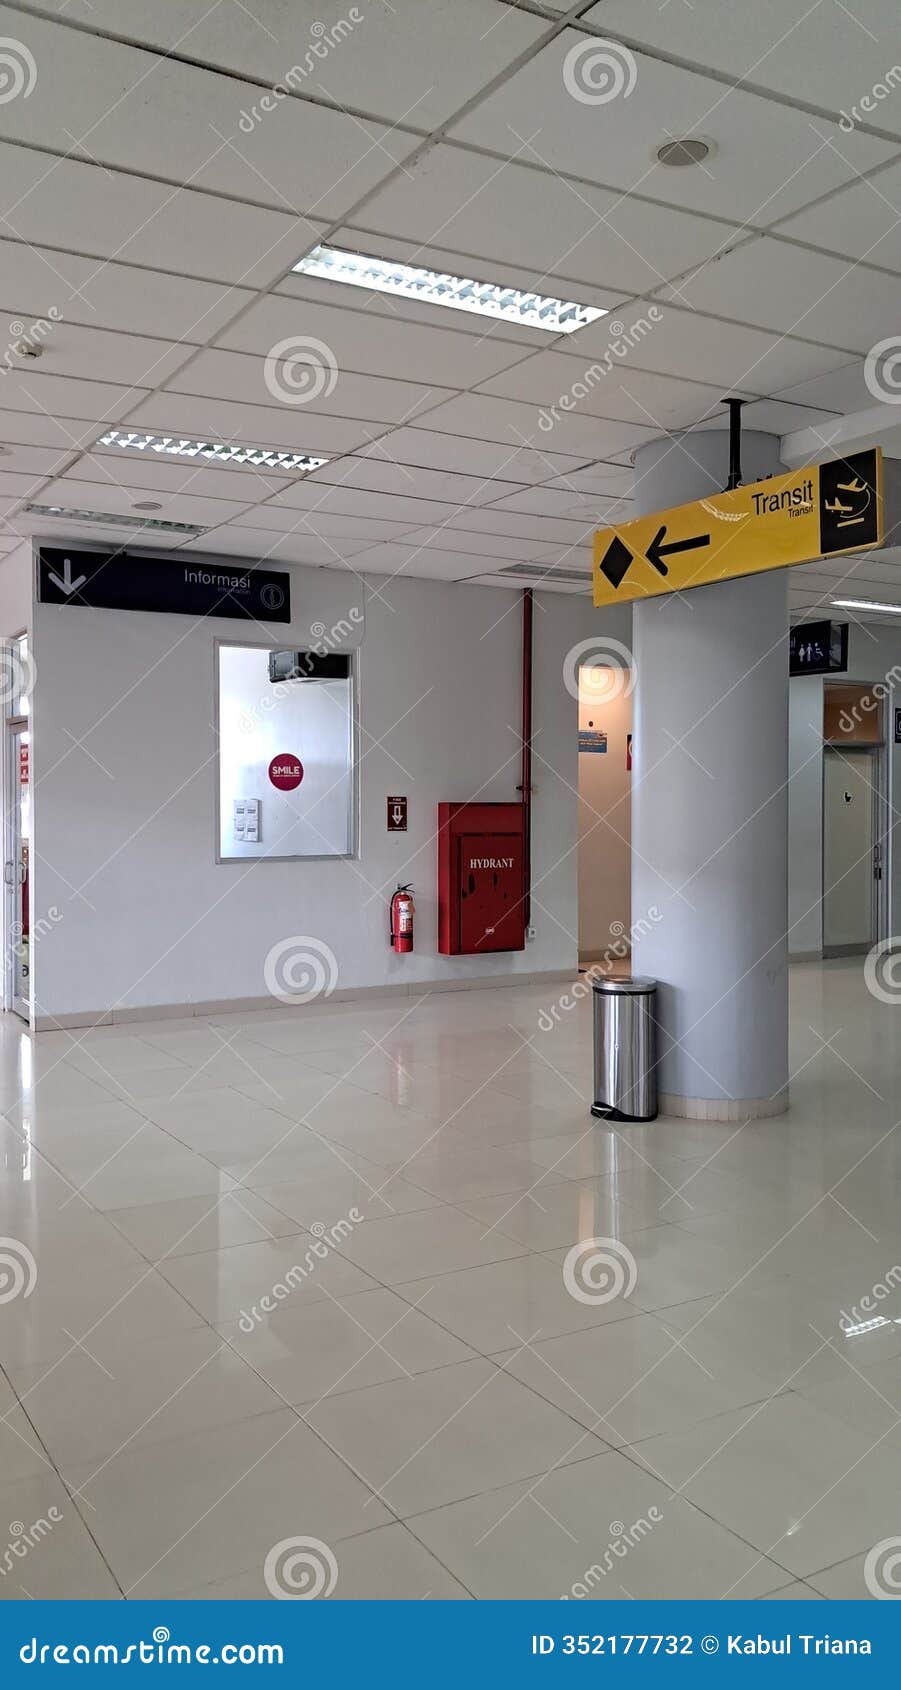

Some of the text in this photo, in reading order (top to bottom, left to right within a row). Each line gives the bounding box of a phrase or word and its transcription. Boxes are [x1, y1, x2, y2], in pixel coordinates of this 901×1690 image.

[751, 480, 813, 515] Transit
[788, 504, 814, 518] Transit
[184, 569, 251, 588] Informasi
[272, 766, 300, 775] SMILE
[470, 858, 514, 869] HYDRANT
